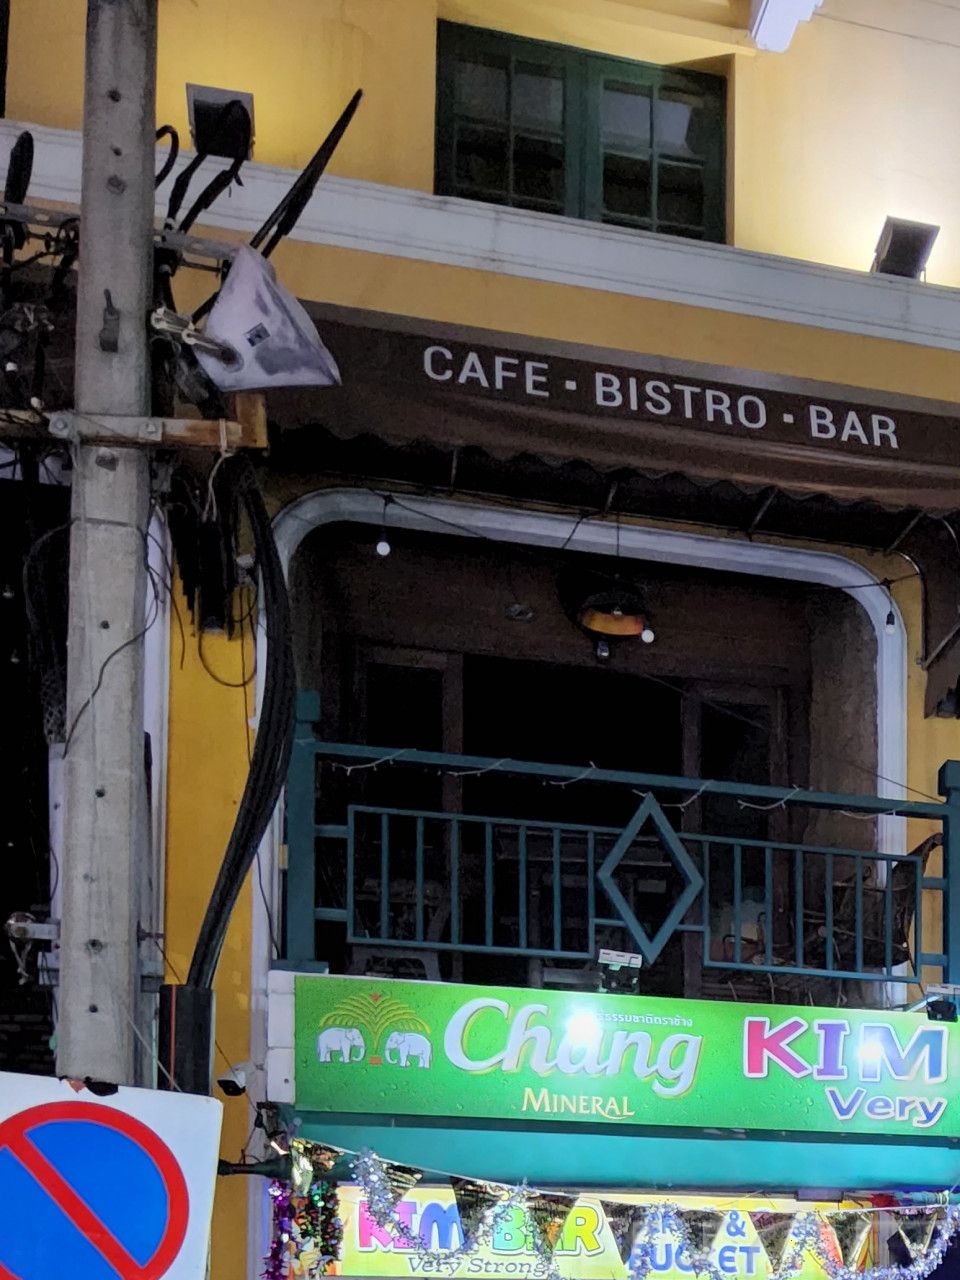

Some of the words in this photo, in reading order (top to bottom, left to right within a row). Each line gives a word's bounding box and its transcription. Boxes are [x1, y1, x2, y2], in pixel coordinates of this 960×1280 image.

[424, 345, 550, 397] CAFE
[595, 372, 767, 429] BISTRO
[809, 404, 899, 449] BAR
[444, 997, 704, 1098] Chang
[743, 1016, 949, 1084] KIM
[521, 1087, 636, 1120] MINERAL
[825, 1087, 947, 1128] Very
[726, 1210, 747, 1237] &
[407, 1256, 461, 1277] Very
[466, 1257, 547, 1277] Strong
